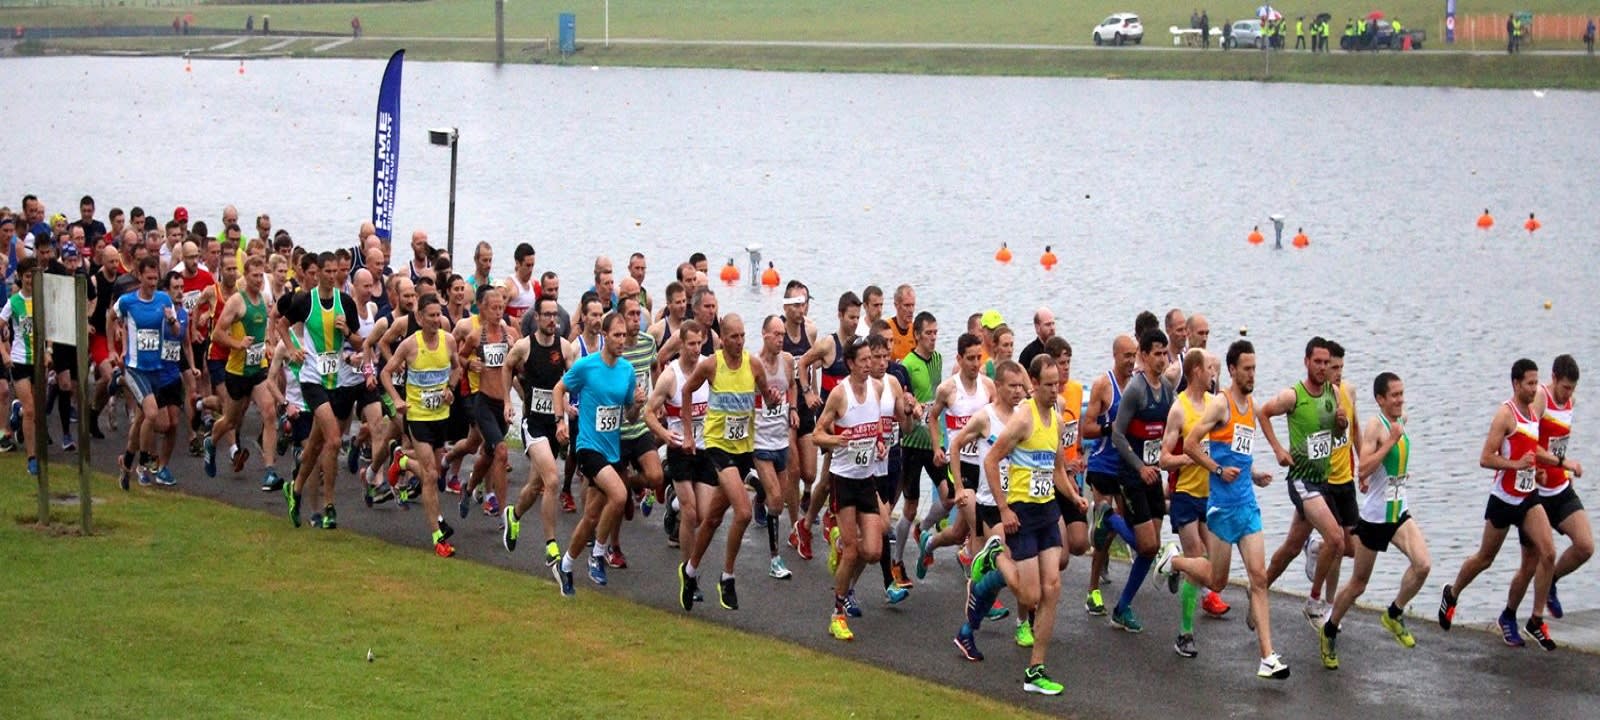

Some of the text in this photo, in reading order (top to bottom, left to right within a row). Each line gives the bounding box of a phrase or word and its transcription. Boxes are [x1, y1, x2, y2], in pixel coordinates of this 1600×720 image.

[376, 112, 388, 229] HOLME
[382, 111, 393, 230] PIERREPONT
[322, 360, 337, 372] 179
[489, 353, 504, 365] 200
[535, 400, 553, 411] 644
[601, 416, 617, 430] 559
[729, 425, 745, 439] 583
[1236, 437, 1250, 451] 244
[1313, 443, 1329, 458] 590
[855, 451, 868, 465] 66
[1033, 480, 1051, 496] 562
